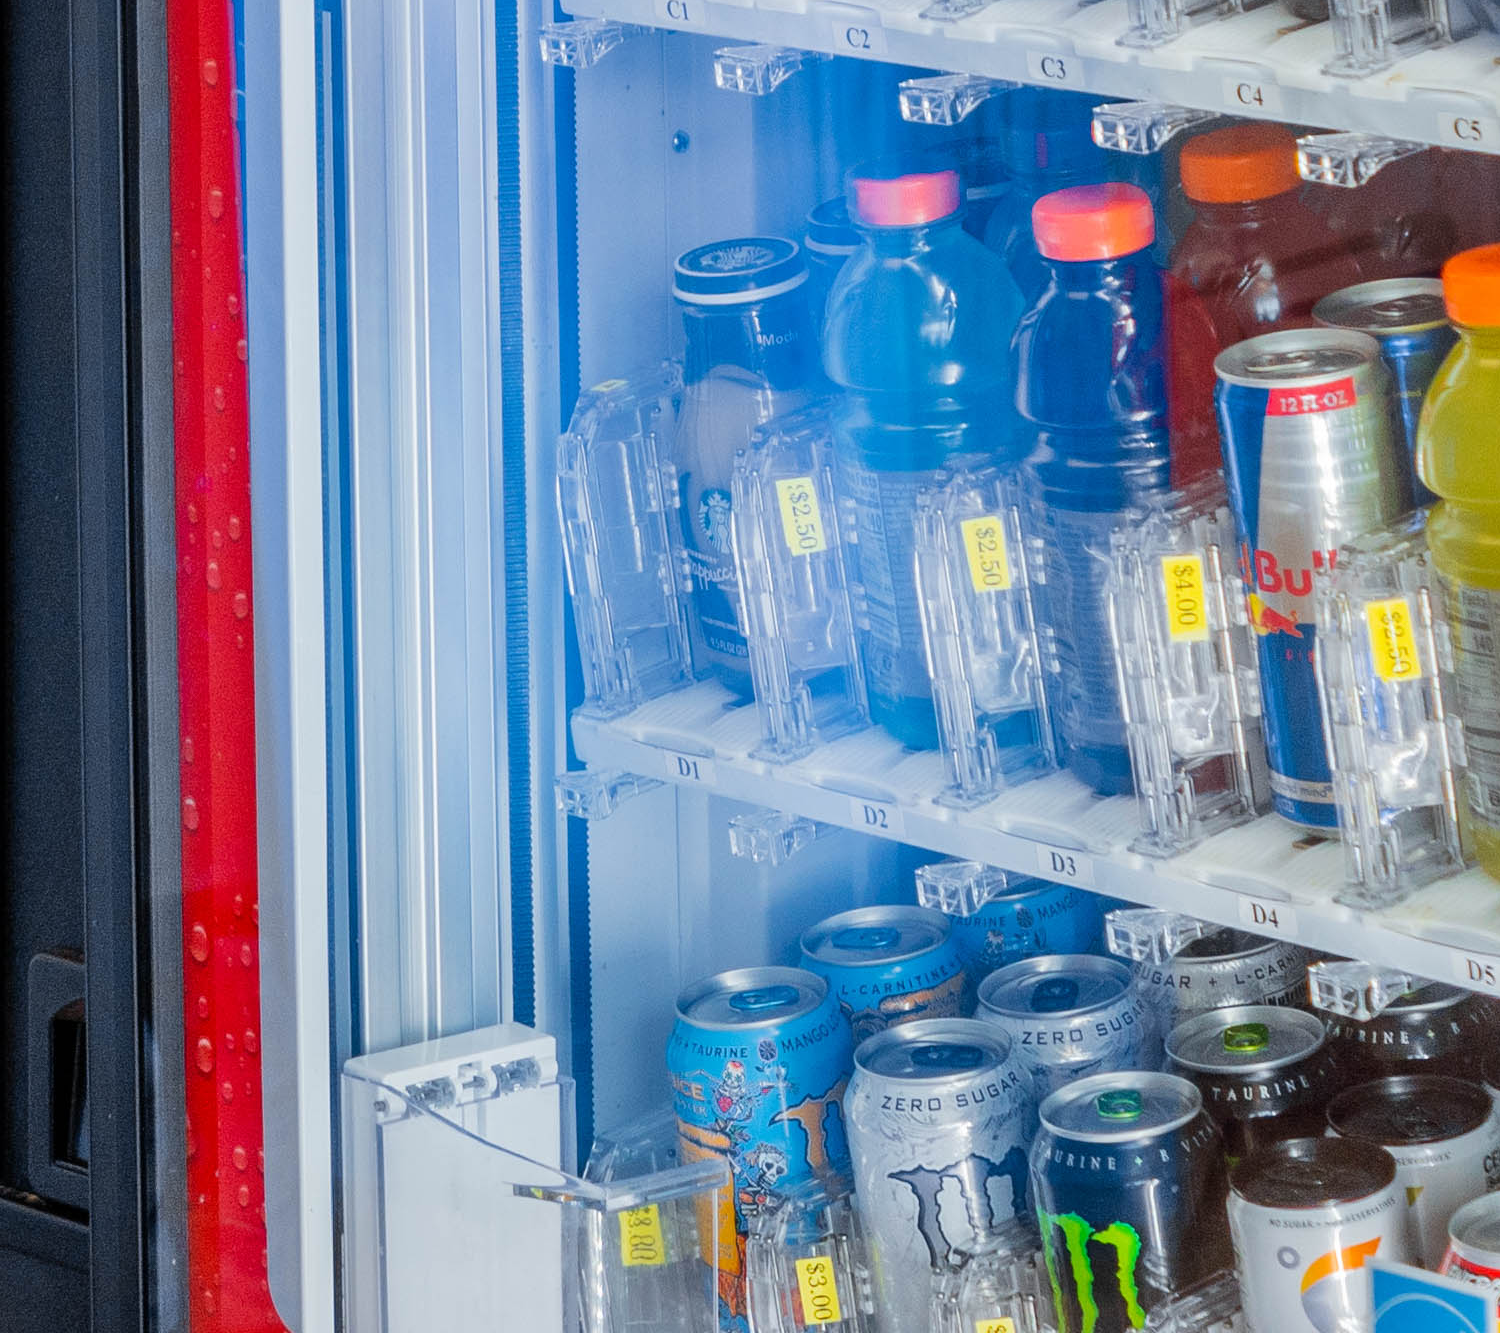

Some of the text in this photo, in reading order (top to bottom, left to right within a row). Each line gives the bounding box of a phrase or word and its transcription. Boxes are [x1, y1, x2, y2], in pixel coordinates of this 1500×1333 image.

[846, 26, 872, 50] C2
[1041, 56, 1067, 81] C3
[1236, 83, 1263, 108] C4
[1453, 117, 1482, 142] C5
[1280, 397, 1298, 412] 12
[791, 489, 819, 551] $2.50
[977, 525, 1003, 589] $2.50
[1171, 563, 1197, 631] $4.00
[1379, 611, 1411, 675] $2.50
[678, 757, 700, 779] D1
[864, 805, 889, 829] D2
[1050, 851, 1078, 876] D3
[1252, 902, 1279, 930] D4
[1467, 958, 1496, 986] D5
[1022, 999, 1146, 1046] ZERO SUGAR
[690, 1025, 830, 1059] TAURINE MANGO
[880, 1071, 1021, 1113] ZERO SUGAR
[1211, 1075, 1310, 1102] TAURINE
[804, 1262, 834, 1322] $3.00
